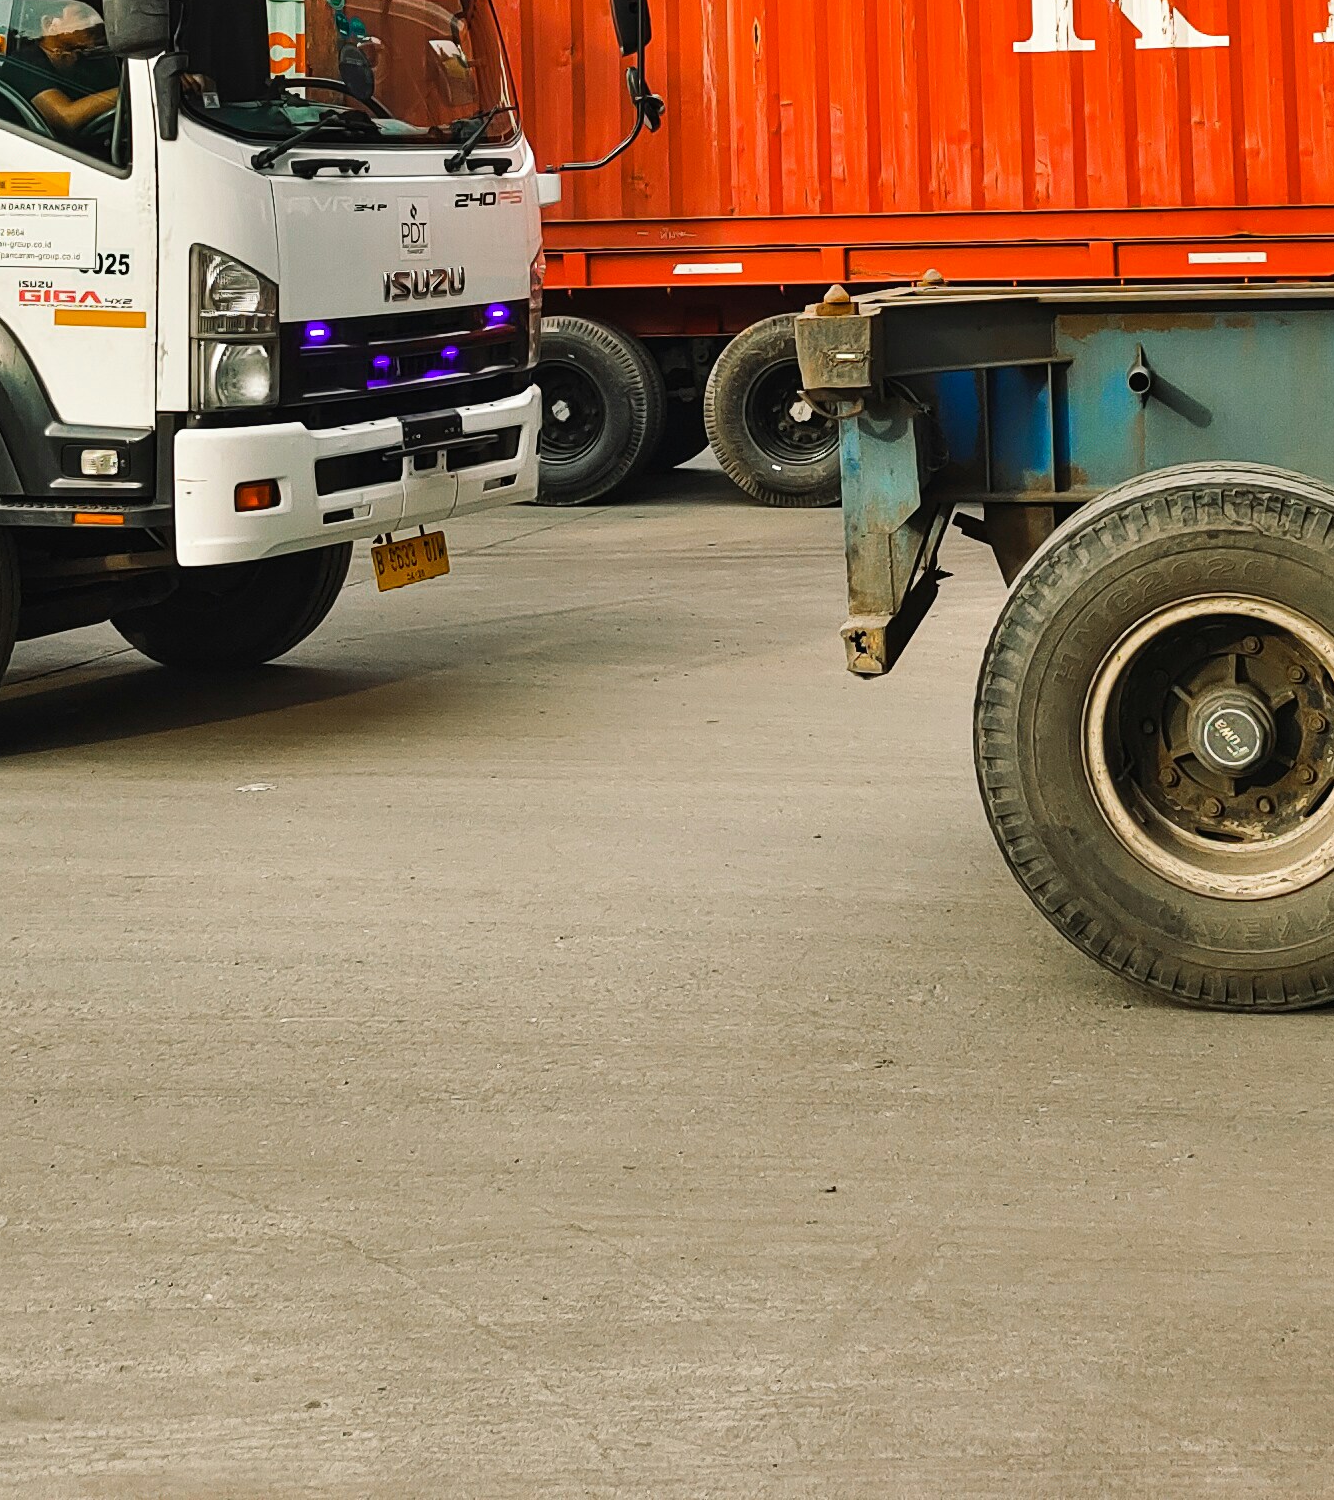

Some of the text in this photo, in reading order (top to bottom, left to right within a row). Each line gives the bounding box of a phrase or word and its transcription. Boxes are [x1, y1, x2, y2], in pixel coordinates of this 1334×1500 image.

[8, 203, 36, 211] DARAT
[37, 203, 89, 212] TRANSPORT
[400, 222, 428, 244] PDT
[18, 280, 53, 289] ISUZU
[382, 265, 466, 303] ISUZU
[18, 289, 102, 304] GIGA
[375, 550, 386, 576] B
